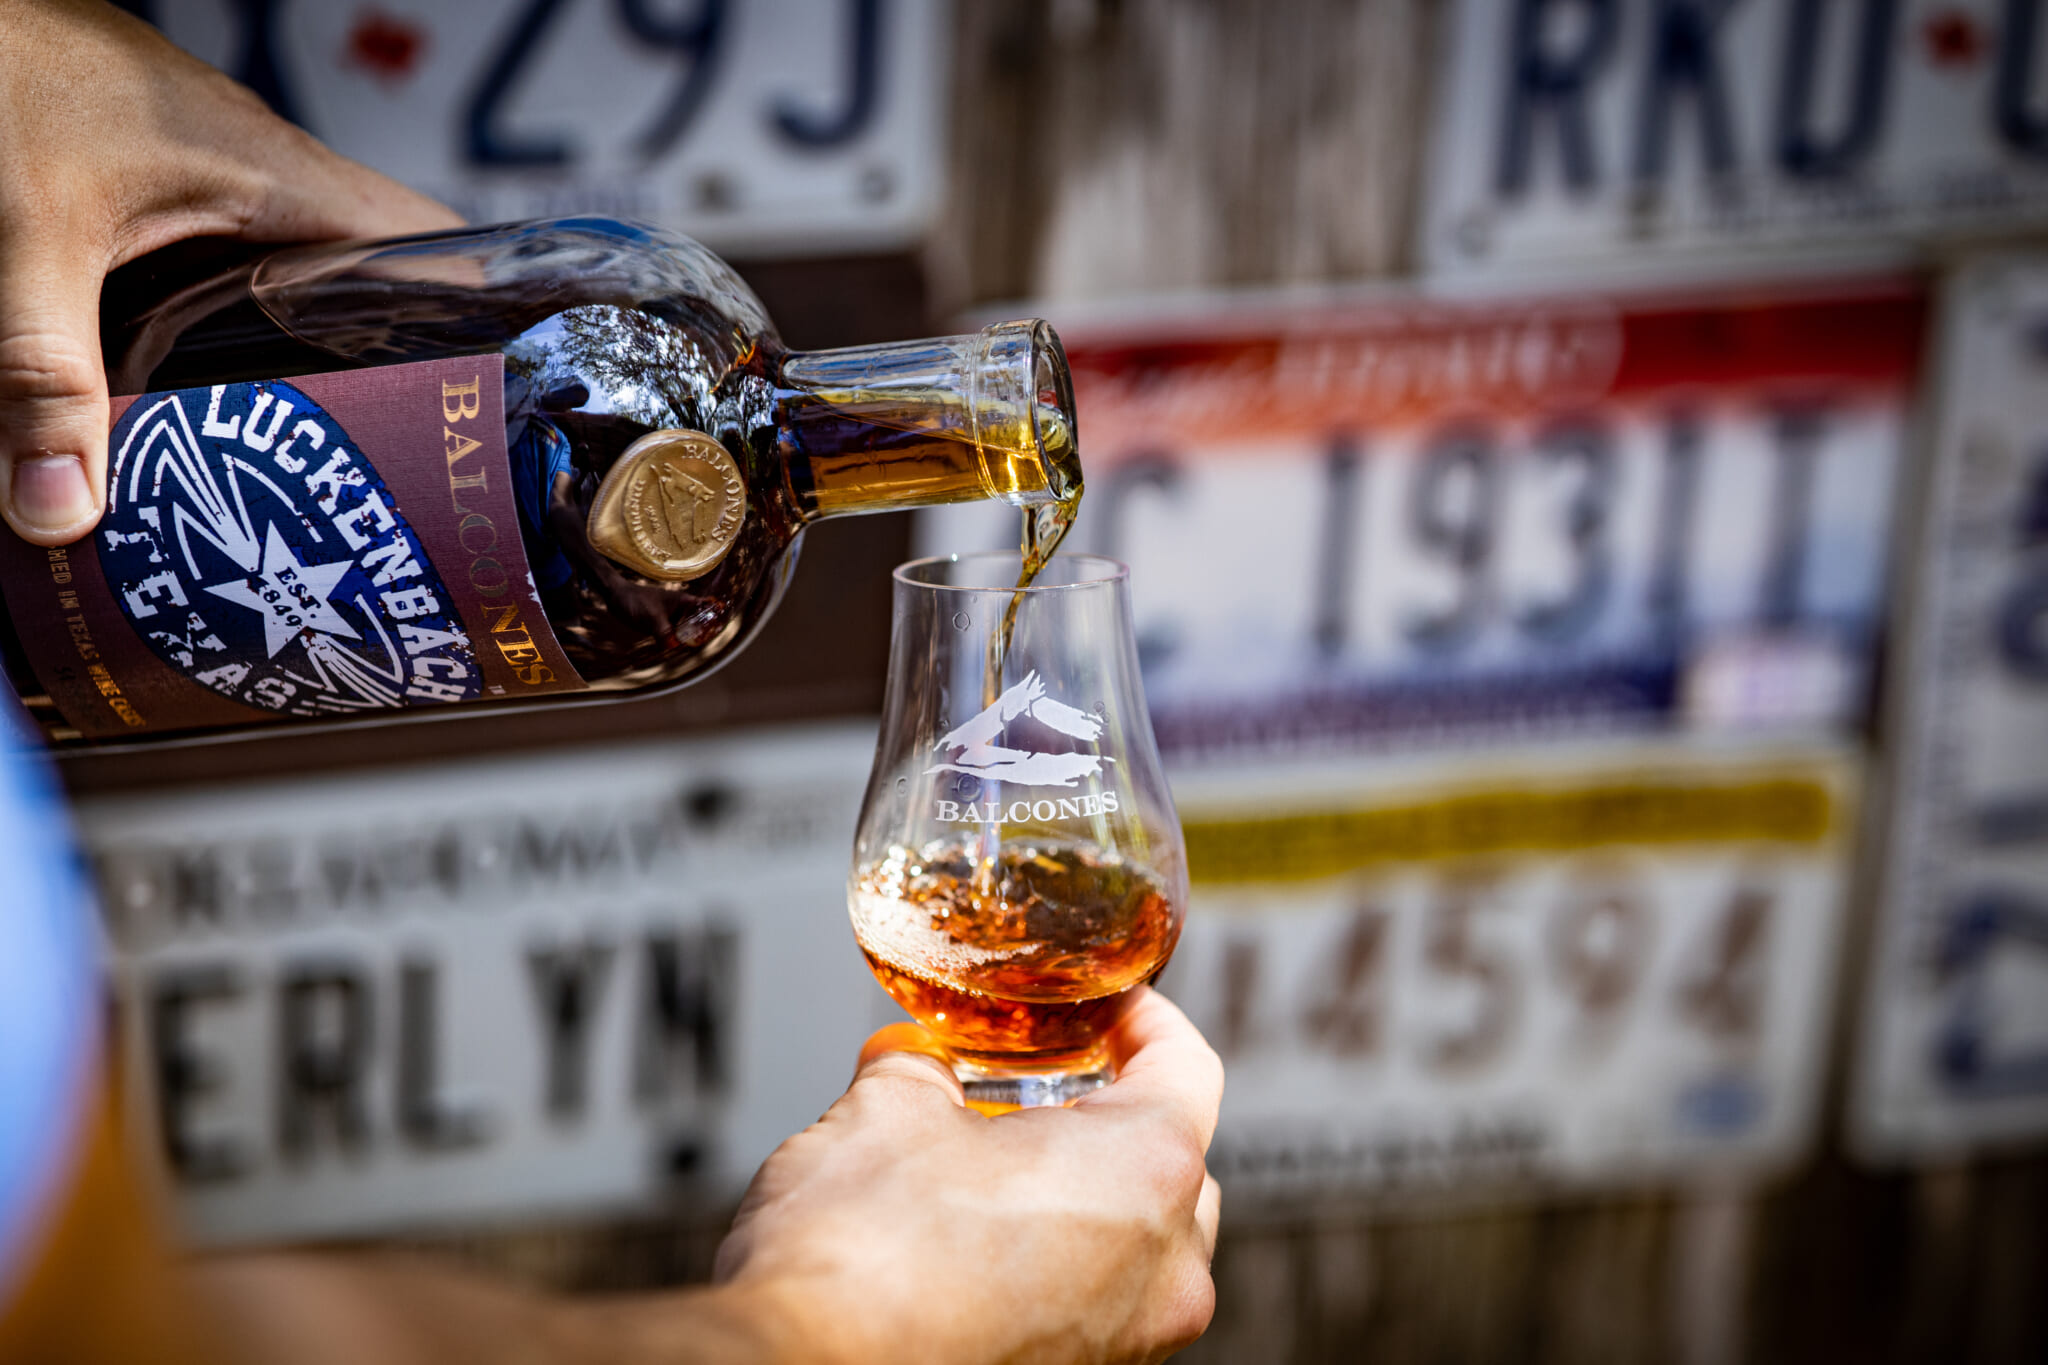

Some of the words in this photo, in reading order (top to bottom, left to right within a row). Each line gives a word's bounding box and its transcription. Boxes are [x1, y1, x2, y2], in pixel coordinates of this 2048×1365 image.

[47, 547, 73, 584] HED
[201, 385, 470, 702] LUCKENBACH
[274, 566, 322, 618] EST.
[442, 375, 556, 685] BALCONES
[104, 505, 297, 710] TEXAS
[935, 790, 1119, 824] BALCONES
